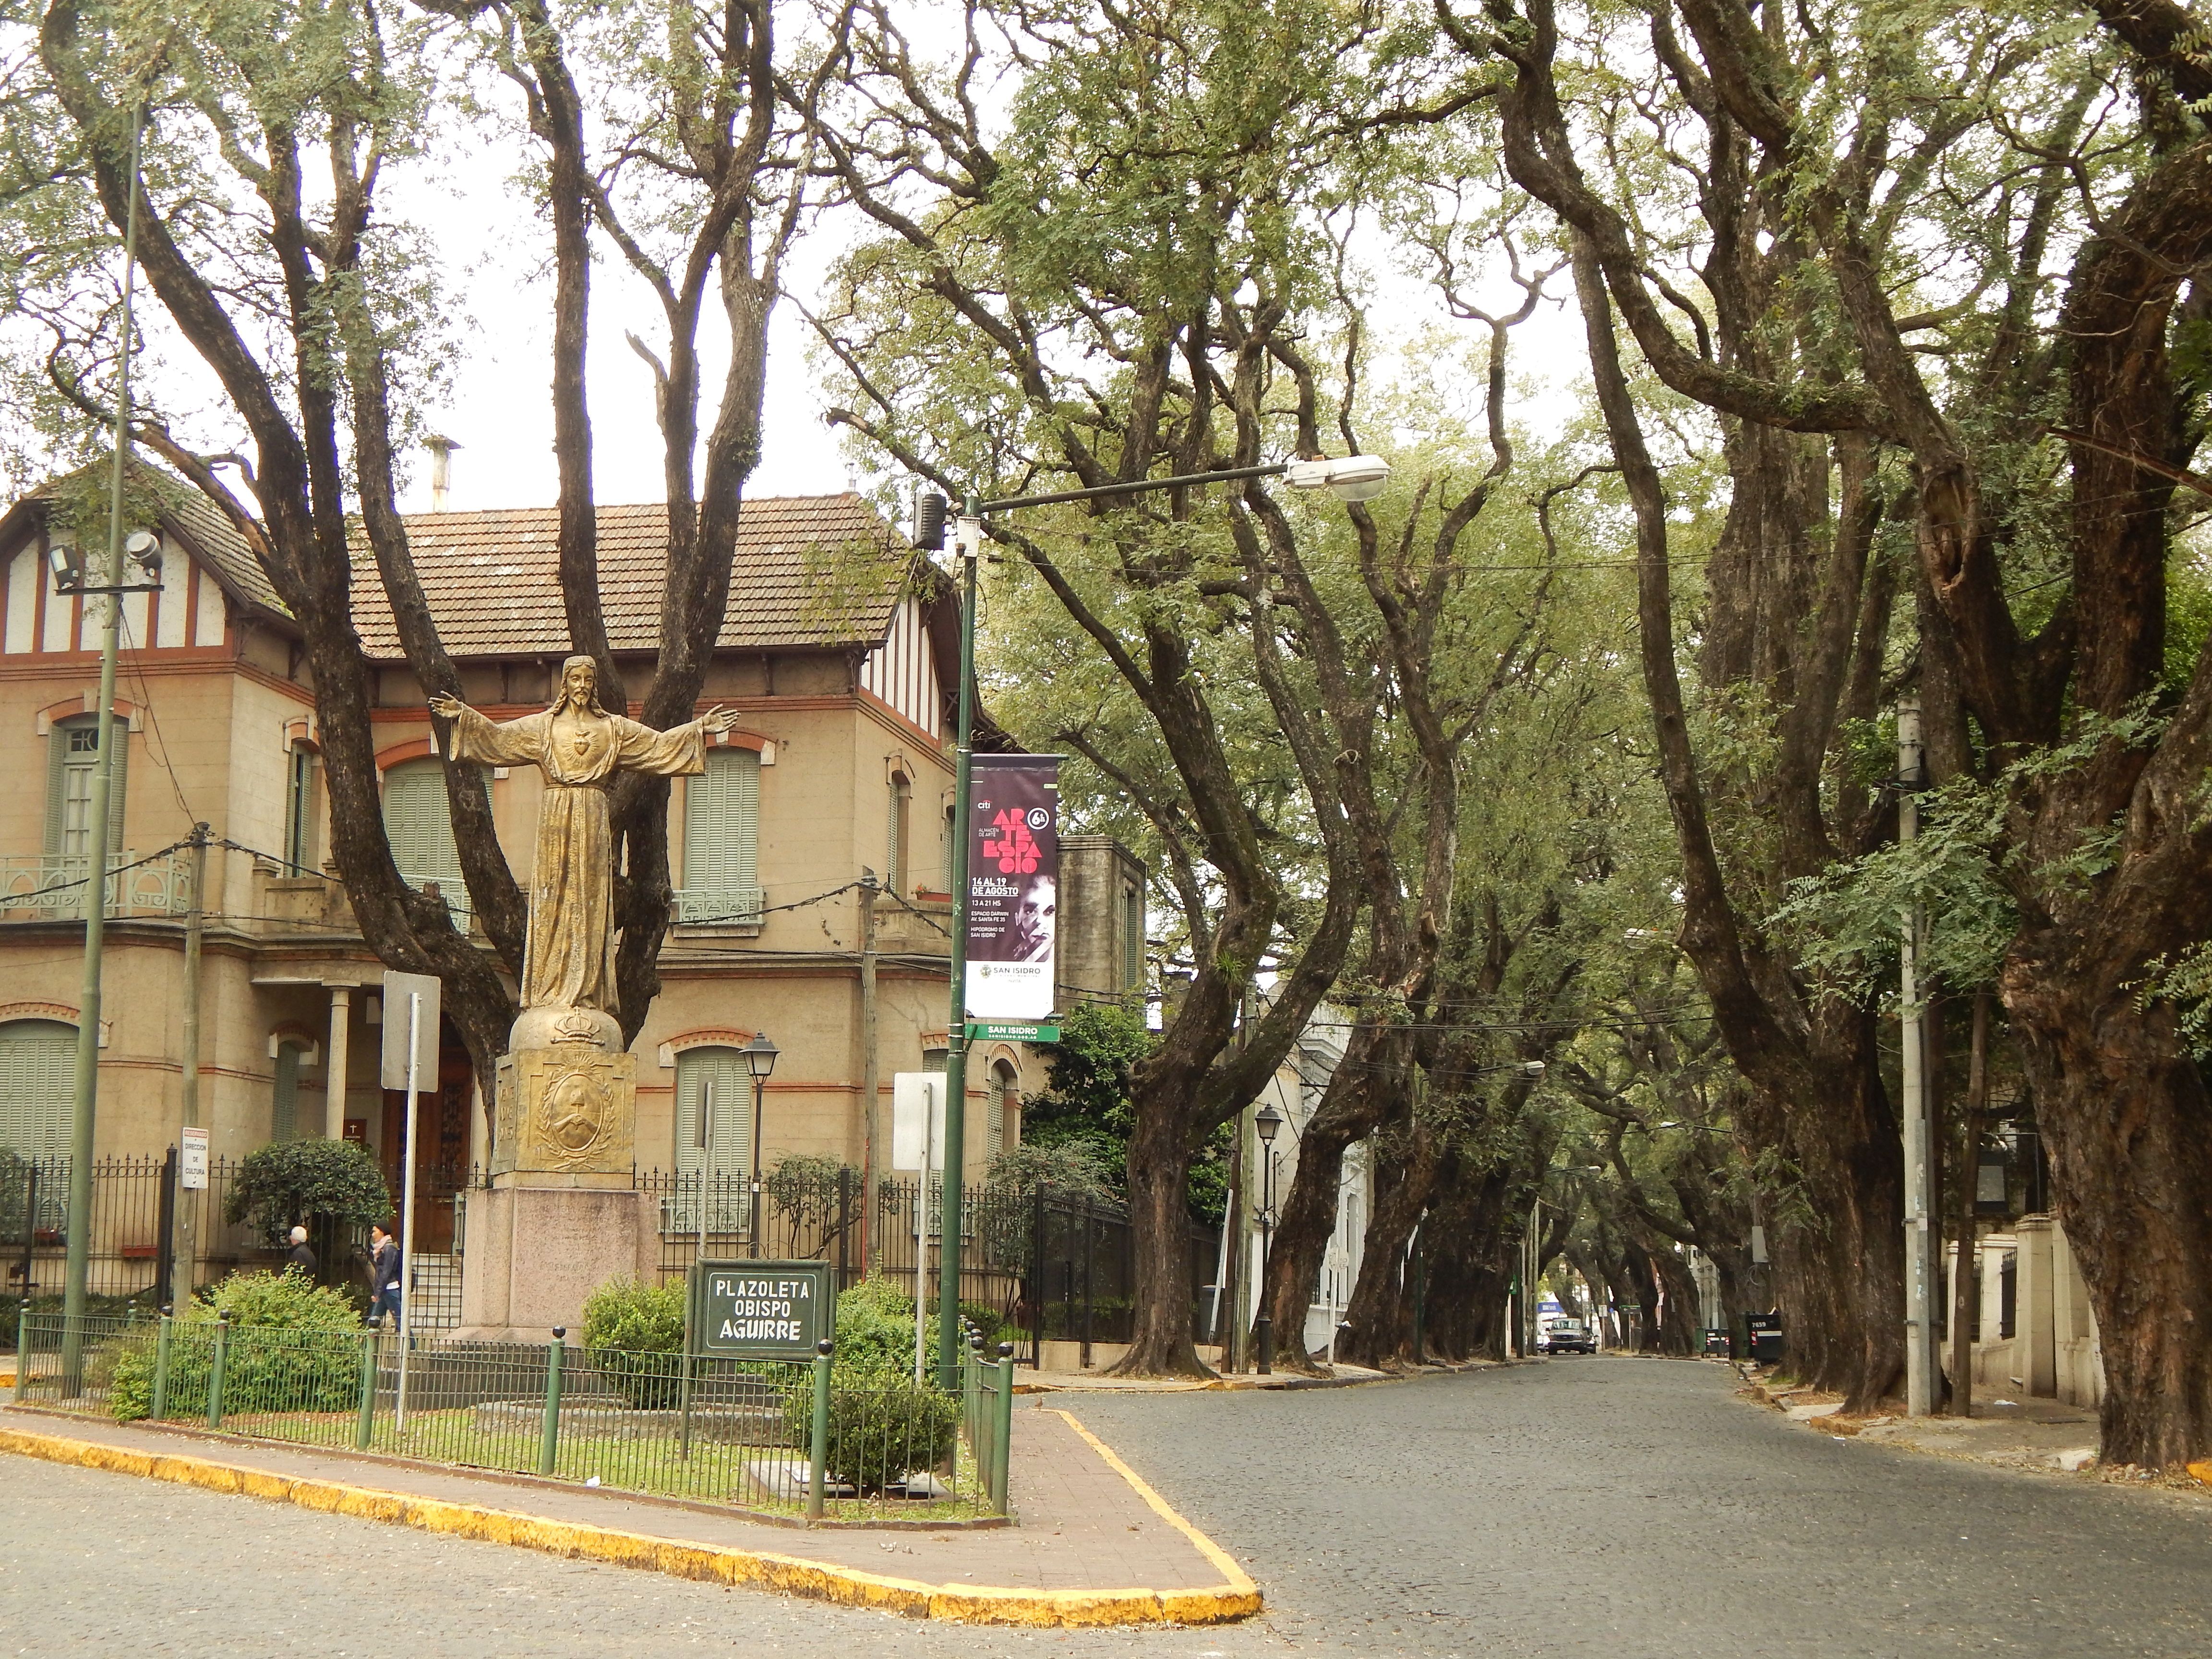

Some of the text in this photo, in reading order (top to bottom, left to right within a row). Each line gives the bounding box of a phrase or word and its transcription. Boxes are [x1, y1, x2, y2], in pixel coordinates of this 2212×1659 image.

[972, 877, 1007, 886] 14 AL 19
[972, 887, 1019, 895] DE AGOSTO
[1008, 1026, 1038, 1034] ISIDRO
[716, 1280, 809, 1298] PLAZOLETA
[735, 1299, 791, 1317] OBISPO
[719, 1319, 802, 1341] AGUIRRE
